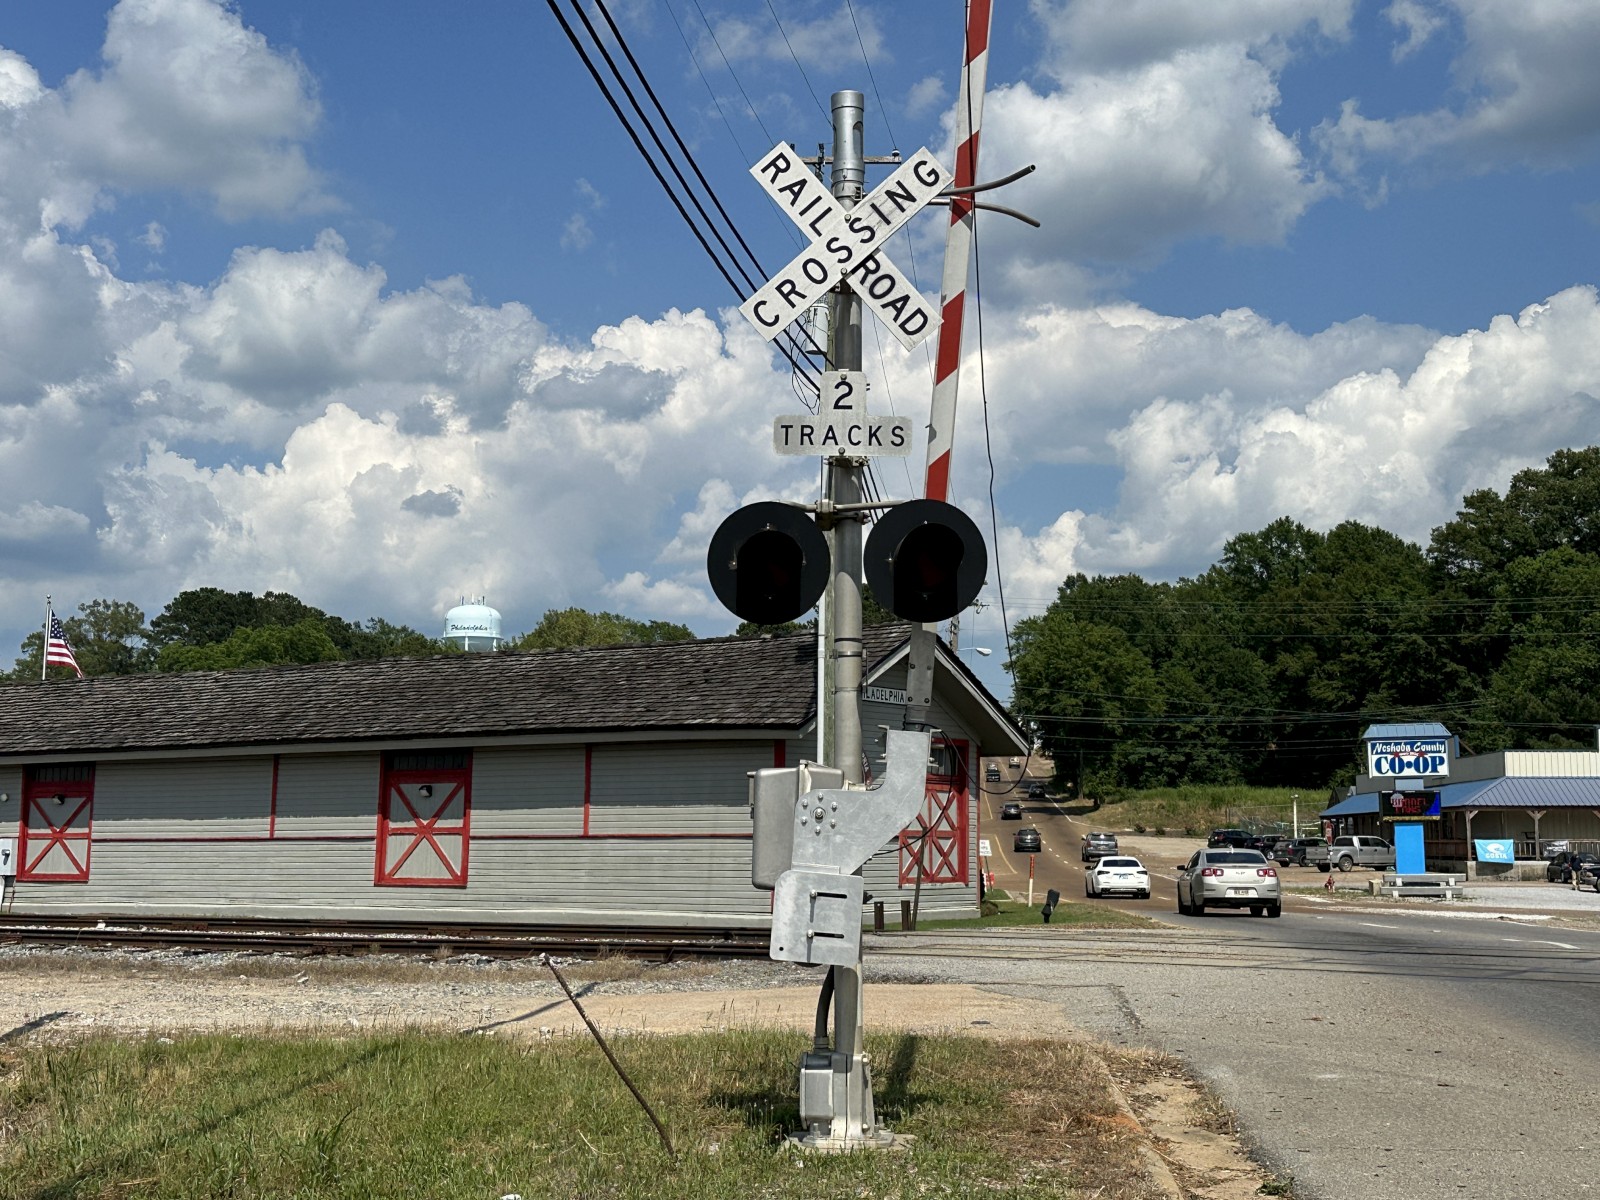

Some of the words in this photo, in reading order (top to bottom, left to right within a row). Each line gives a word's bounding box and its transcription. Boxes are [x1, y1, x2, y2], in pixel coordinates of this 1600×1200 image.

[753, 160, 940, 328] CROSSING
[833, 381, 853, 410] 2
[780, 424, 905, 447] TRACKS
[1373, 742, 1411, 754] Neshoba
[1413, 742, 1445, 753] County
